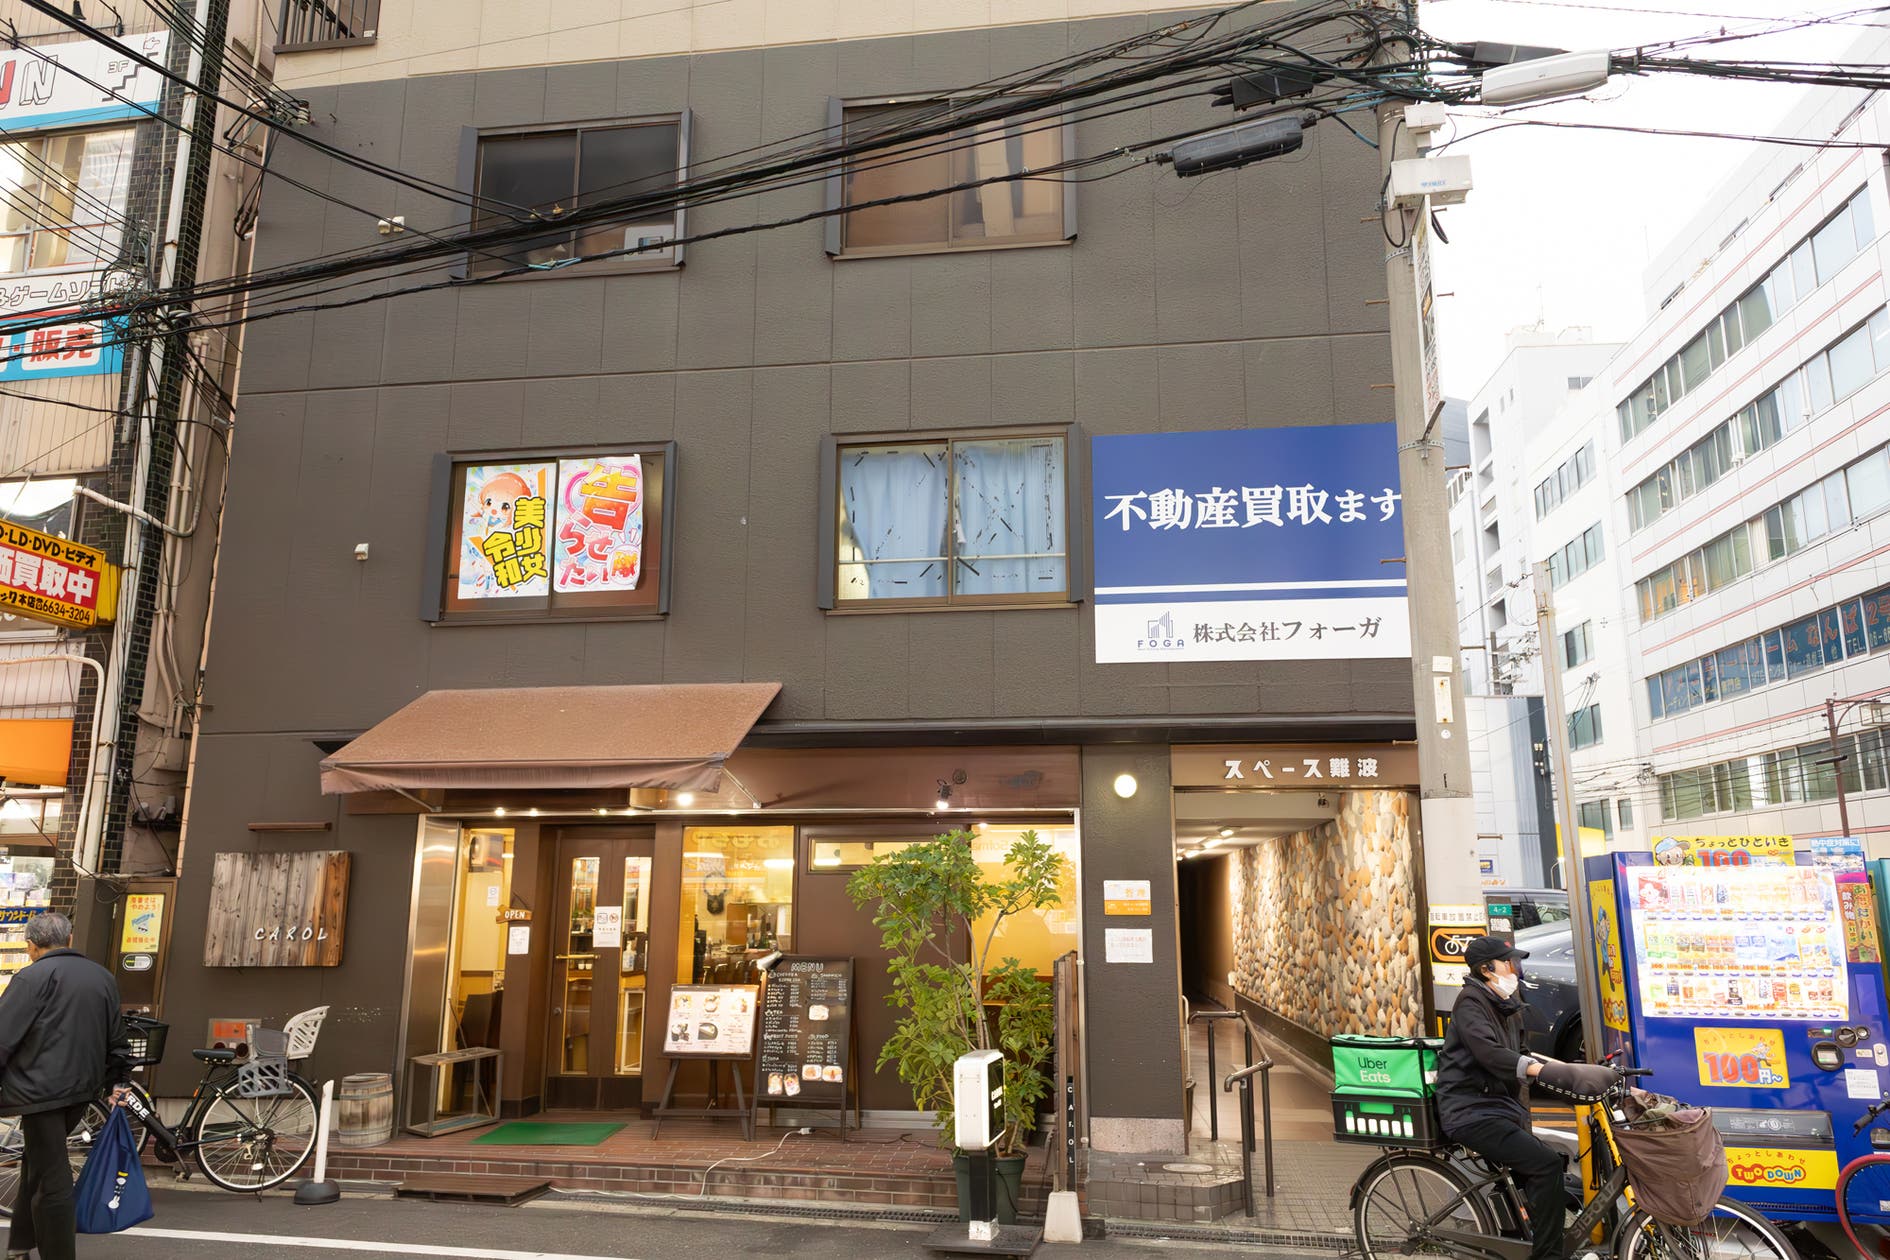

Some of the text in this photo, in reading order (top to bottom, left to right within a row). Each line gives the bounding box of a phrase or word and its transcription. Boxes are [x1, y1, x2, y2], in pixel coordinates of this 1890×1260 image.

[108, 60, 129, 74] 3F
[1104, 483, 1402, 532] 不動産買取ます
[1193, 616, 1383, 644] 株式会社フォーガ
[1137, 639, 1185, 648] FOGA
[1225, 758, 1379, 779] スペース難波
[1696, 838, 1790, 847] ちょっとひといき
[504, 910, 526, 919] OPEN
[254, 927, 328, 941] CAROL
[1357, 1057, 1388, 1069] Uber
[1360, 1070, 1391, 1083] Eats
[1767, 1168, 1803, 1181] DOWN
